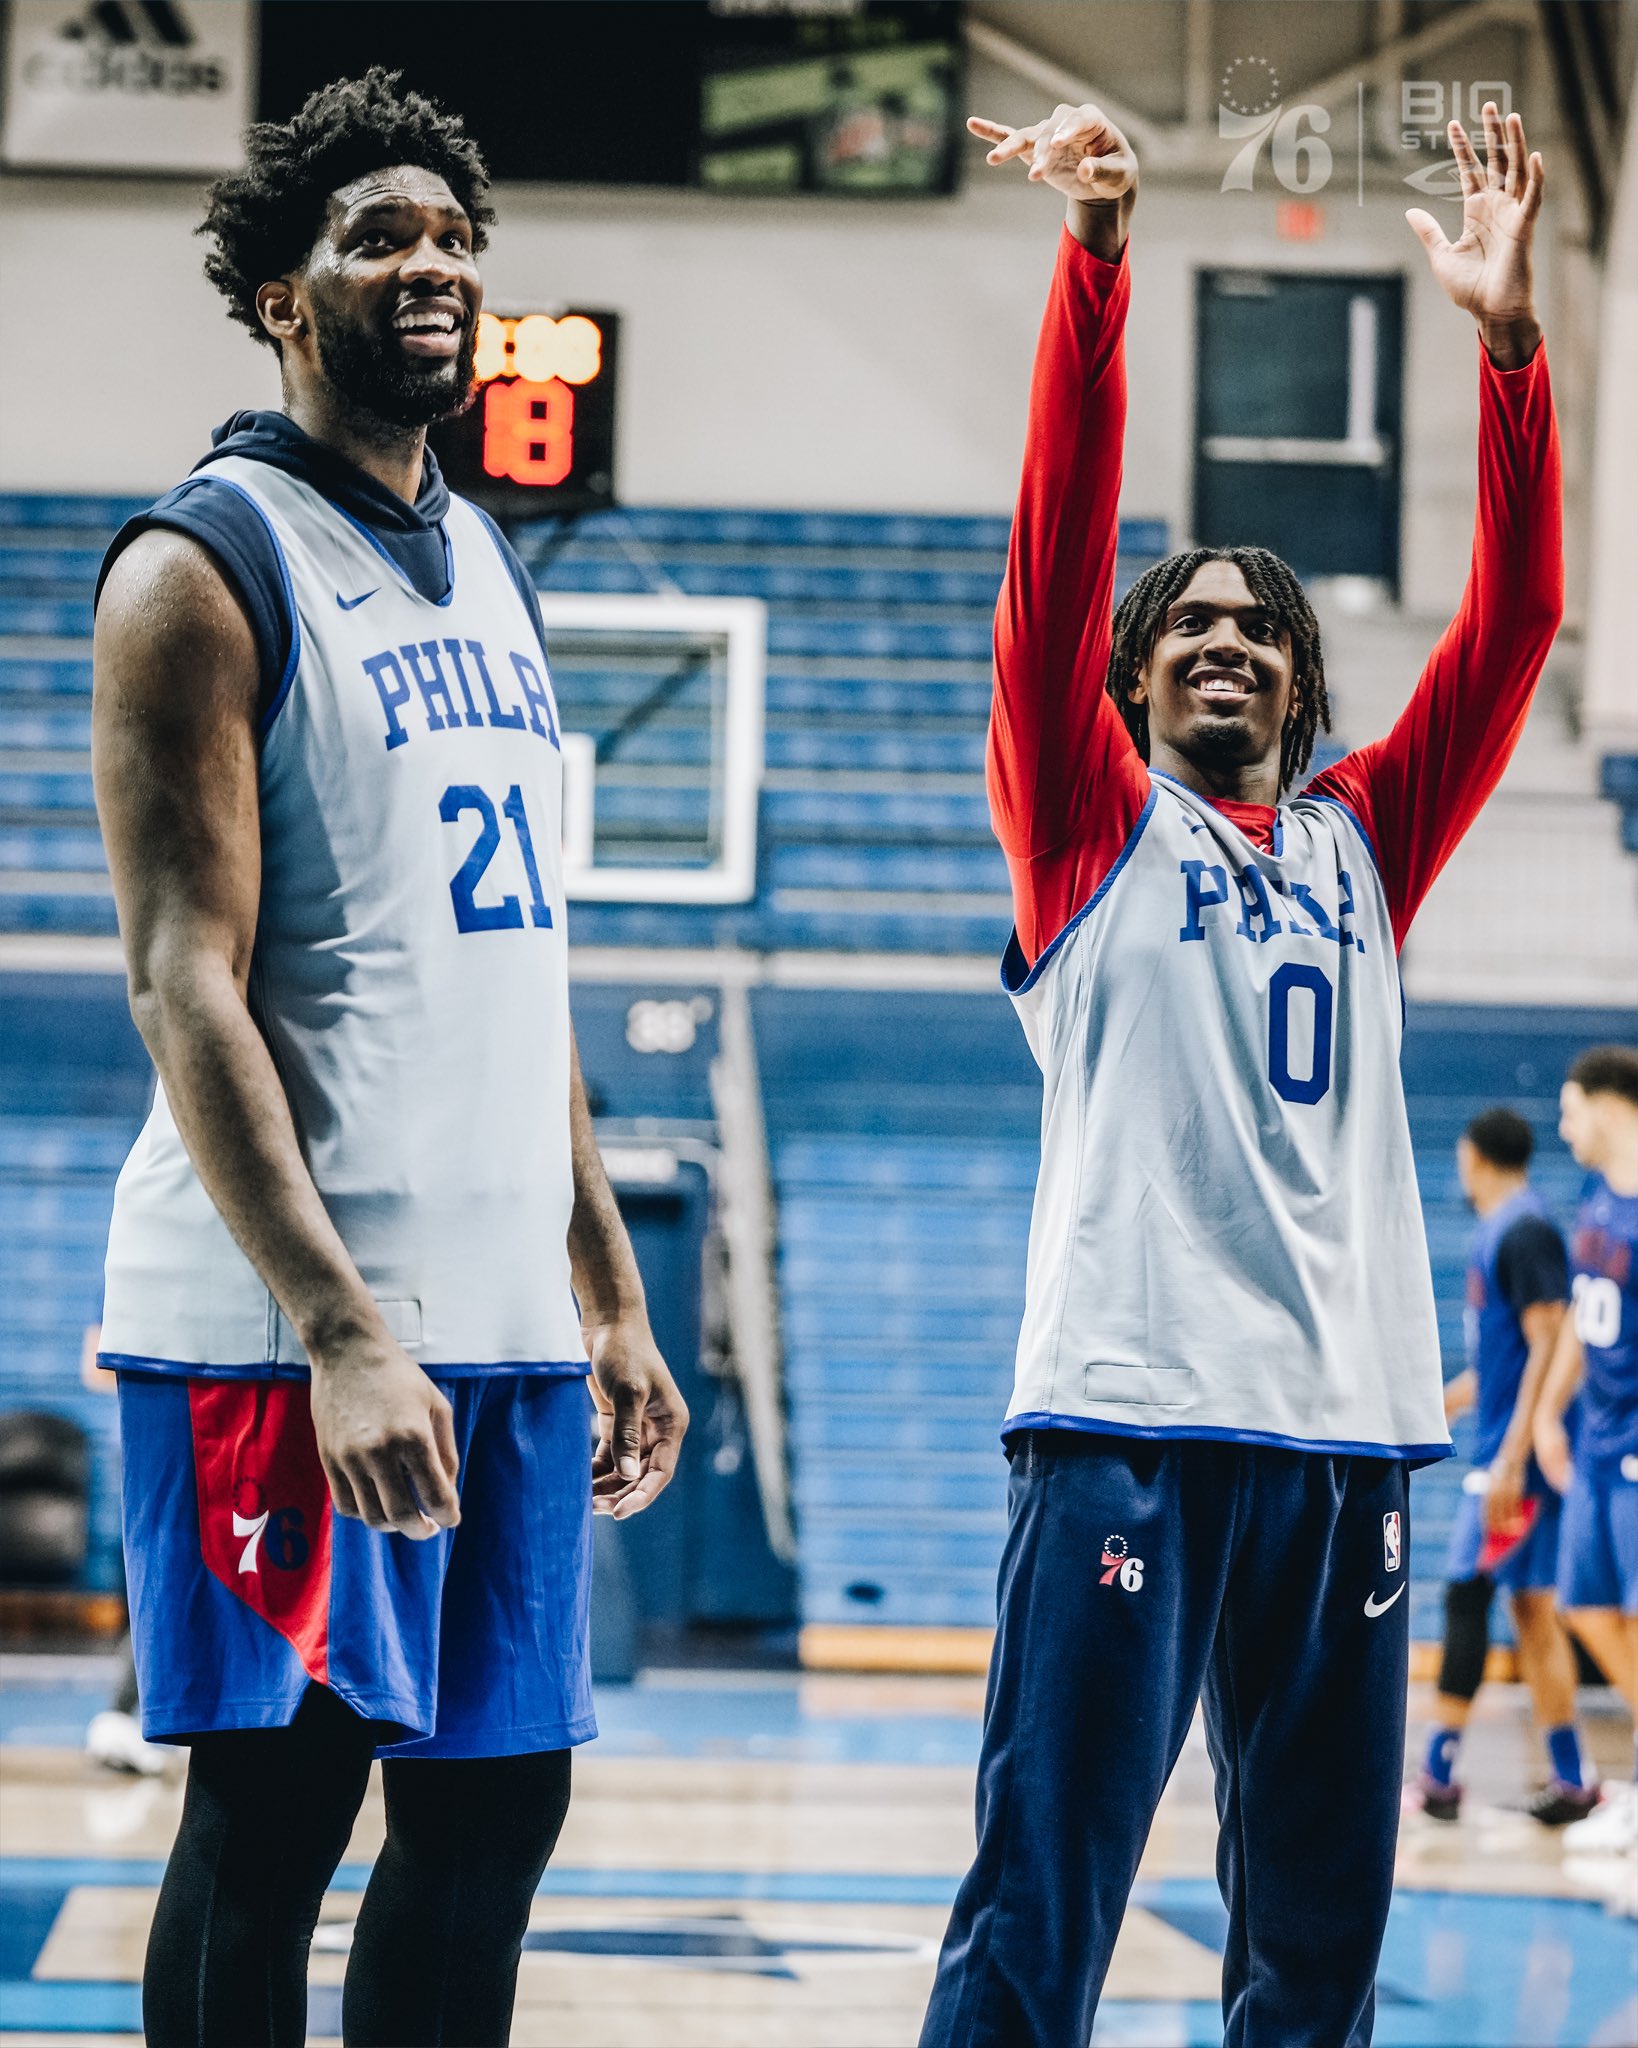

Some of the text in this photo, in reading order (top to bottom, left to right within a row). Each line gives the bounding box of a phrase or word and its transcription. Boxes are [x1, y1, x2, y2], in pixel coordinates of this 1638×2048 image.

[361, 638, 560, 752] PHILA
[439, 784, 553, 934] 21
[1269, 962, 1333, 1106] 0
[233, 1507, 309, 1575] 76
[1099, 1551, 1145, 1593] 76
